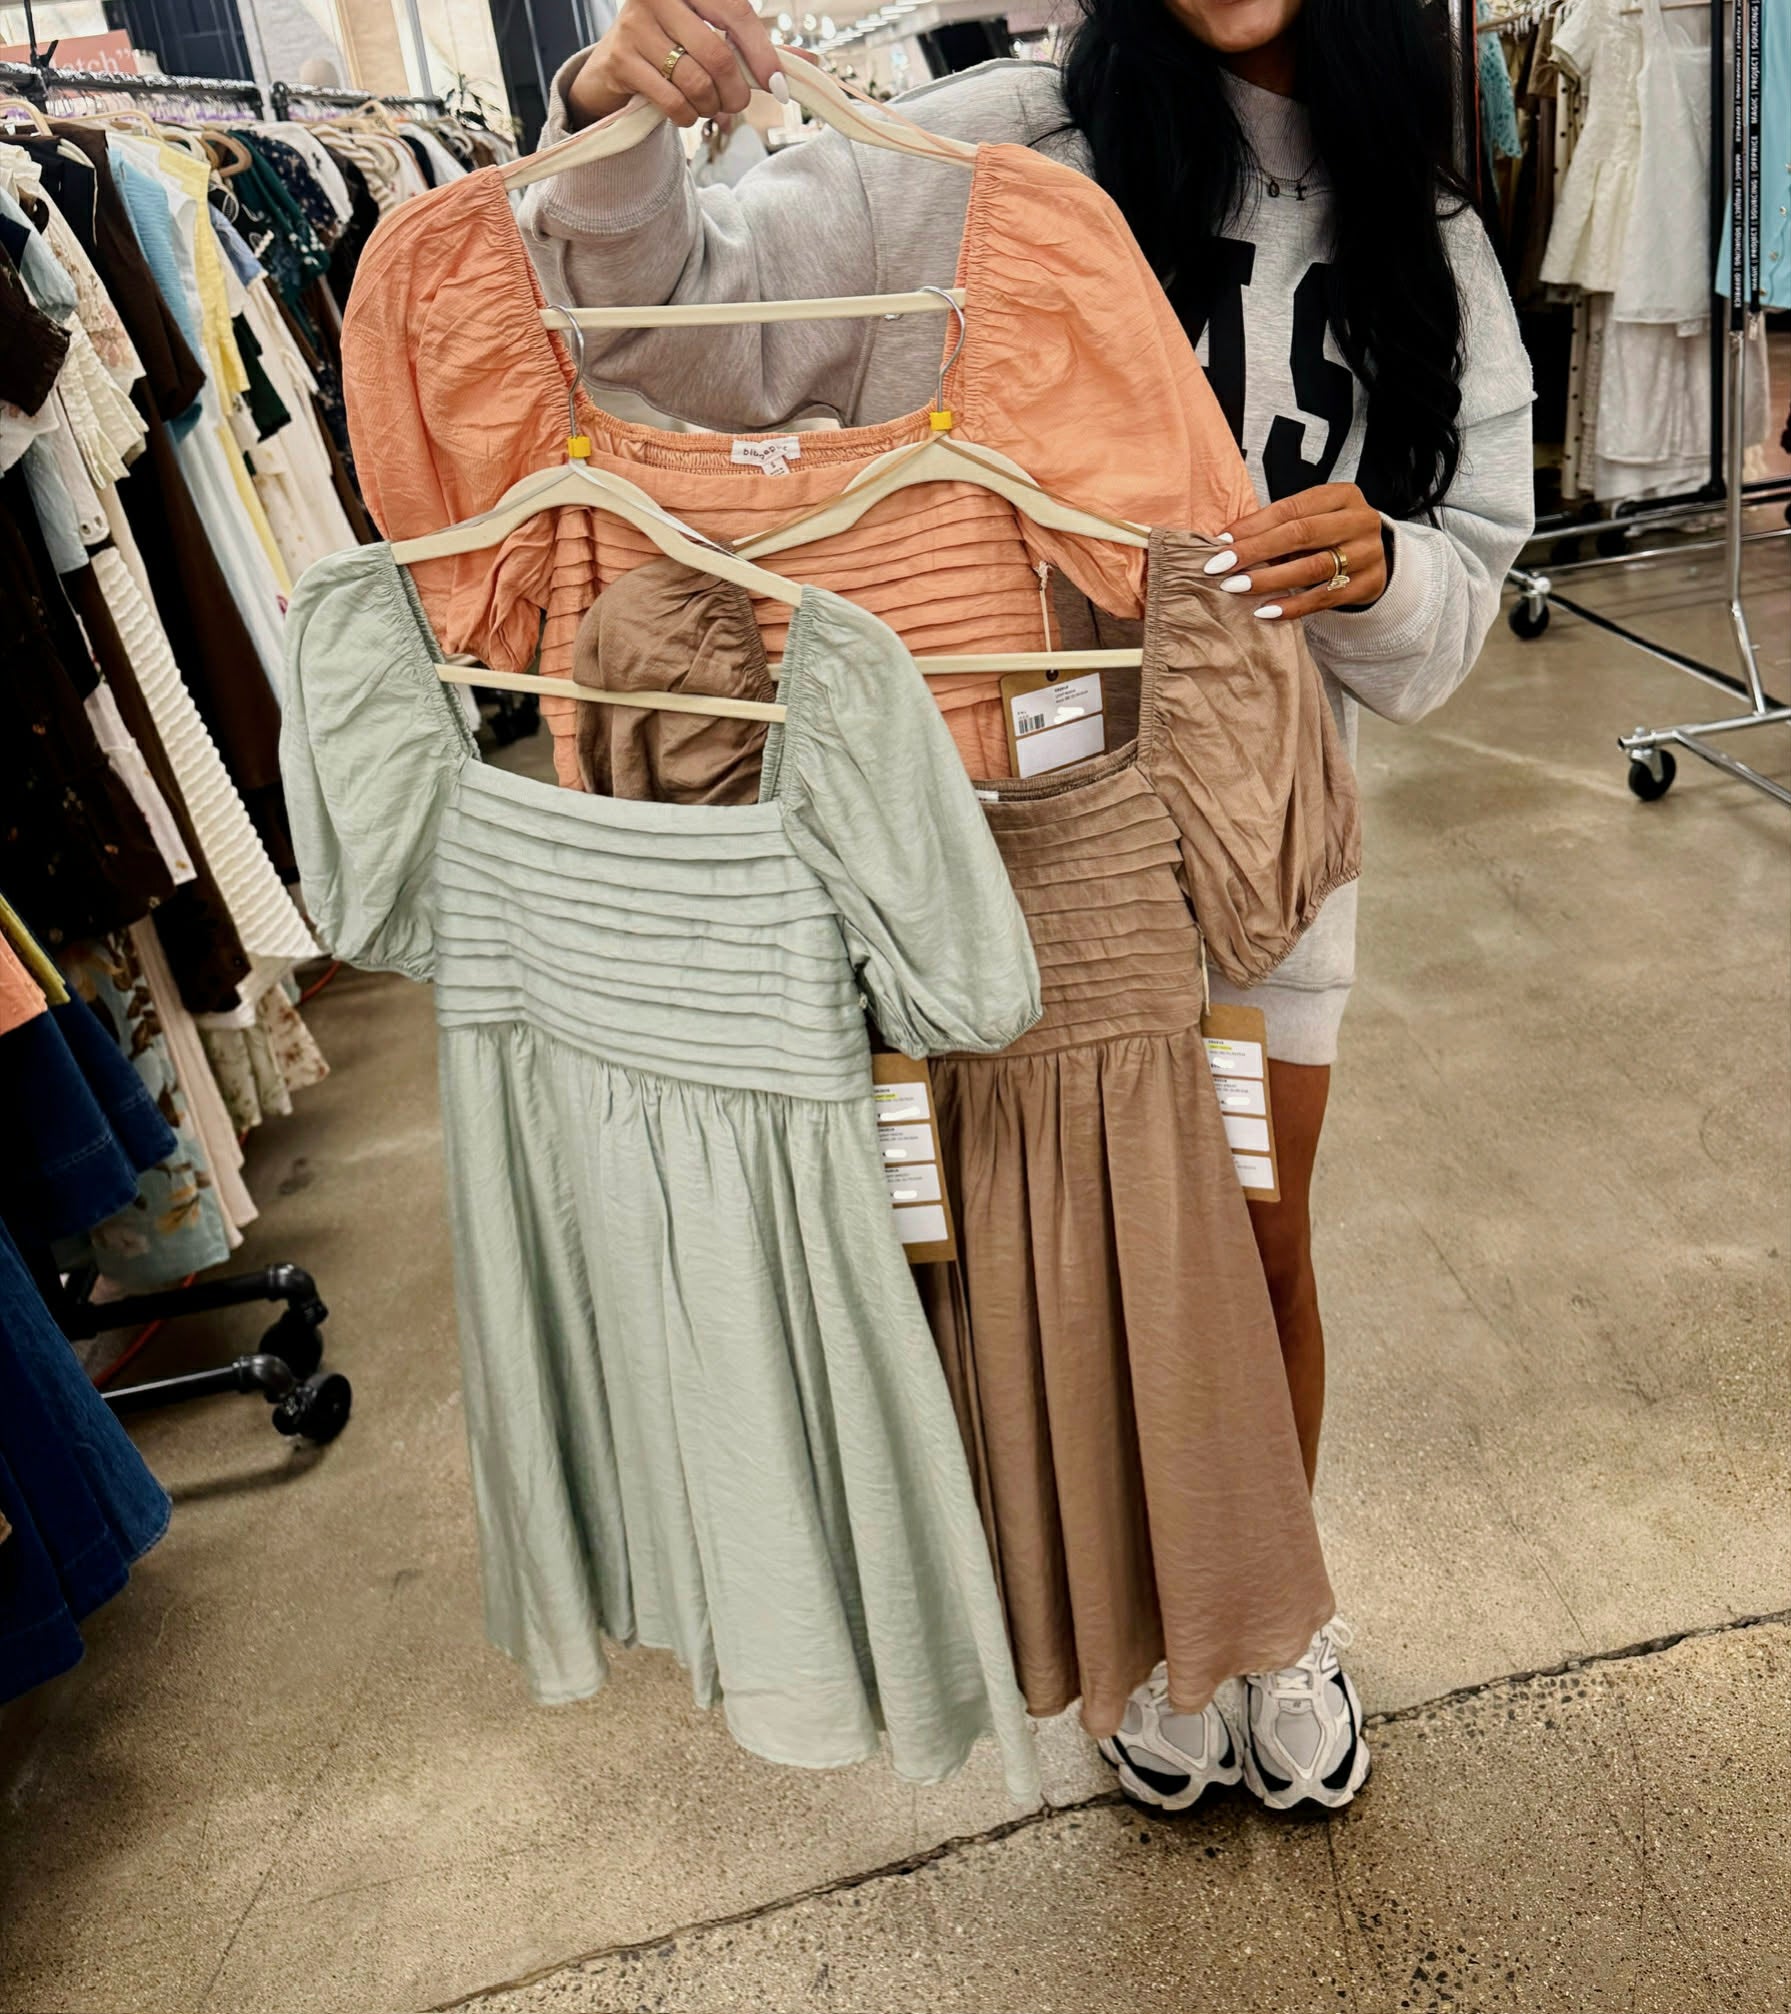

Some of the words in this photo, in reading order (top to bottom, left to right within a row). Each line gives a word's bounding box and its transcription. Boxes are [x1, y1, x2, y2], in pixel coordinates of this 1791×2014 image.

[1751, 6, 1759, 49] SOURCING
[1750, 57, 1760, 90] PROJECT
[1750, 97, 1758, 124] MAGIC
[1750, 135, 1758, 172] OFFPRICE
[1734, 188, 1742, 220] PROJECT
[1750, 179, 1758, 220] SOURCING
[1734, 227, 1742, 267] SOURCING
[1750, 227, 1758, 258] PROJECT
[1733, 272, 1742, 308] OFFPRICE
